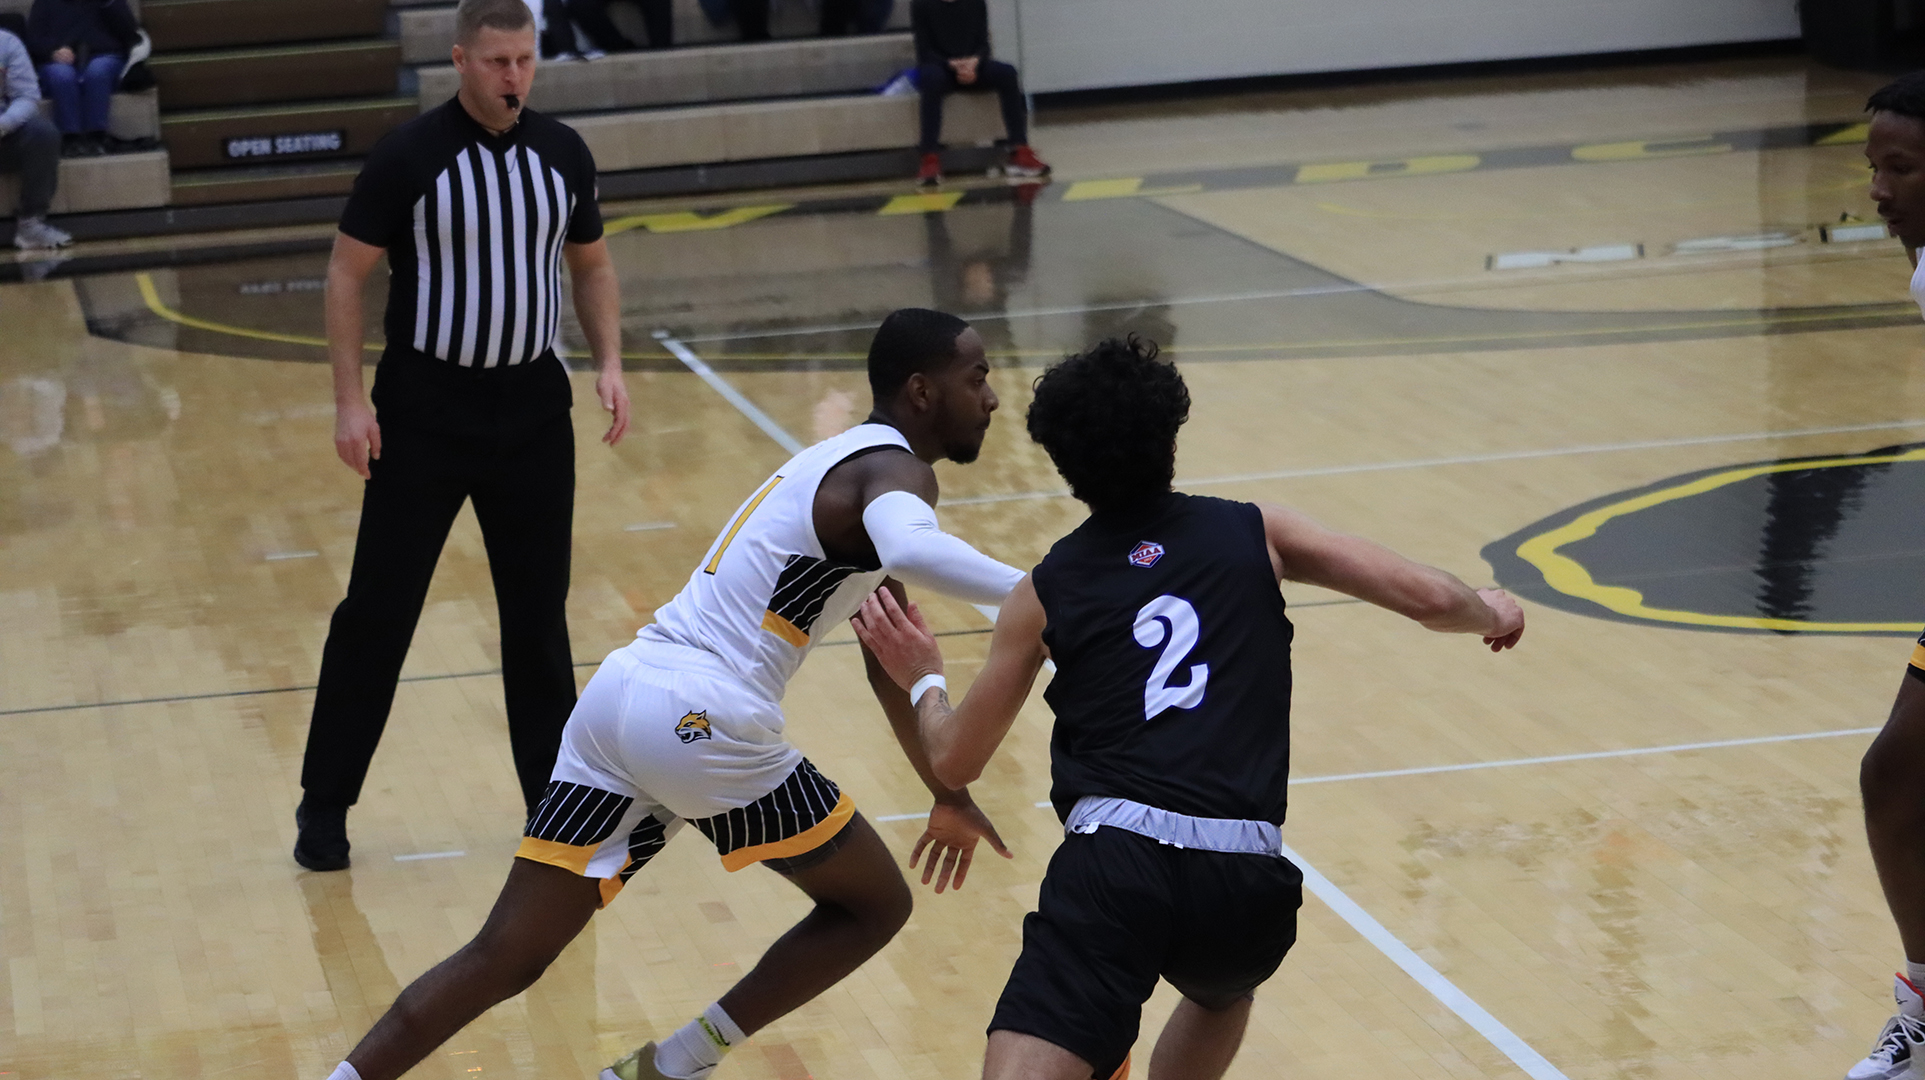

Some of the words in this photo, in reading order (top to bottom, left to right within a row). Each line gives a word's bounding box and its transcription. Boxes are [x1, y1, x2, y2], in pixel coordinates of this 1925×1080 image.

[227, 138, 272, 157] OPEN
[275, 132, 342, 154] SEATING
[703, 475, 785, 576] 1
[1131, 546, 1162, 562] MIAA
[1132, 593, 1209, 721] 2
